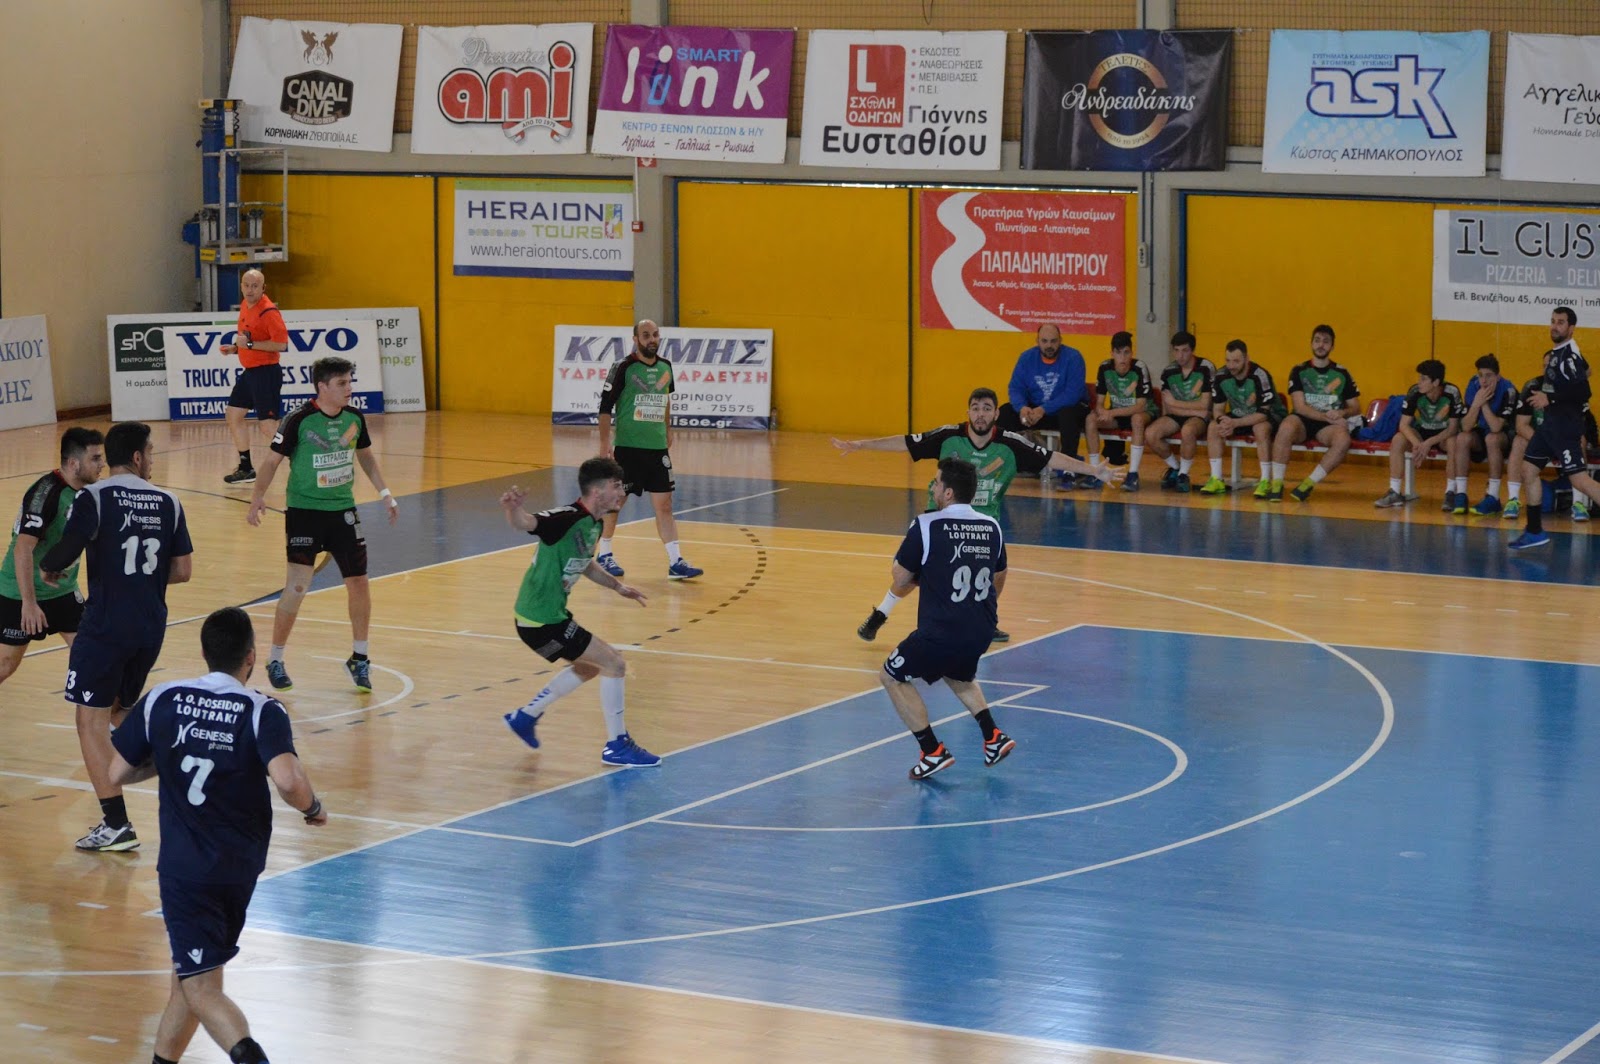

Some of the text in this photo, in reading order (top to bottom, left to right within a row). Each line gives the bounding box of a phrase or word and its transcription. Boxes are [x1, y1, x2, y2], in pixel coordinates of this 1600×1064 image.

[462, 38, 546, 64] Pizzeria
[676, 48, 742, 62] SMART
[920, 48, 961, 57] ΕΚΔΟΣΕΙΣ
[856, 49, 877, 92] L
[918, 60, 983, 70] ΑΝΑΘΕΩΡΗΣΕΙΣ
[438, 40, 576, 124] ami
[622, 45, 770, 110] link
[918, 72, 978, 82] ΜΕΤΑΒΙΒΑΣΕΙΣ
[287, 80, 348, 102] CANAL
[1306, 54, 1458, 138] ask
[296, 98, 334, 118] DIVE
[850, 96, 896, 110] ΣΧΟΛΗ
[1061, 83, 1196, 118] Ανδρεαδάκης
[848, 110, 900, 124] ΟΔΗΓΩΝ
[908, 104, 988, 124] Γιάννης
[264, 128, 308, 140] ΚΟΡΙΝΘΙΑΚΗ
[622, 121, 658, 132] ΚΕΝΤΡΟ
[660, 124, 694, 134] ΞΕΝΩΝ
[740, 127, 745, 136] &
[1533, 127, 1582, 137] Homemade
[622, 136, 656, 152] Αγγλικά
[675, 138, 711, 152] Γαλλικά
[722, 140, 755, 153] Ρωσικά
[822, 126, 987, 156] Ευσταθίου
[1290, 146, 1463, 162] Κώστας ΑΣΗΜΑΚΟΠΟΥΛΟΣ
[468, 200, 603, 222] HERAION
[974, 206, 1115, 221] Πρατήρια Υγρών Καυσίμων
[532, 224, 603, 240] TOURS
[995, 223, 1038, 234] Πλυντήρια
[1044, 224, 1090, 236] Λιπαντήρια
[1456, 218, 1600, 259] IL GUS
[470, 243, 621, 260] www.heraiontours.com
[982, 251, 1108, 276] ΠΑΠΑΔΗΜΗΤΡΙΟΥ
[1486, 264, 1547, 284] PIZZERIA
[1454, 292, 1468, 300] Ελ.
[1471, 293, 1515, 303] Βενιζέλου
[1518, 295, 1530, 304] 45,
[1534, 296, 1578, 307] Λουτράκι
[183, 368, 230, 388] TRUCK
[678, 370, 768, 384] ΑΡΔΕΥΣΗ
[672, 394, 733, 402] ΟΡΙΝΘΟΥ
[711, 404, 754, 412] 75575
[1562, 450, 1572, 464] 3
[118, 498, 158, 510] LOUTRAKI
[128, 493, 164, 502] POSEIDON
[132, 514, 161, 524] GENESIS
[949, 532, 990, 540] LOUTRAKI
[961, 524, 994, 532] POSEIDON
[121, 536, 160, 576] 13
[962, 546, 990, 554] GENESIS
[951, 565, 992, 602] 99
[172, 693, 246, 712] A. O. POSEIDON
[176, 704, 237, 724] LOUTRAKI
[190, 727, 234, 744] GENESIS
[208, 743, 234, 752] pharma
[180, 755, 214, 806] 7
